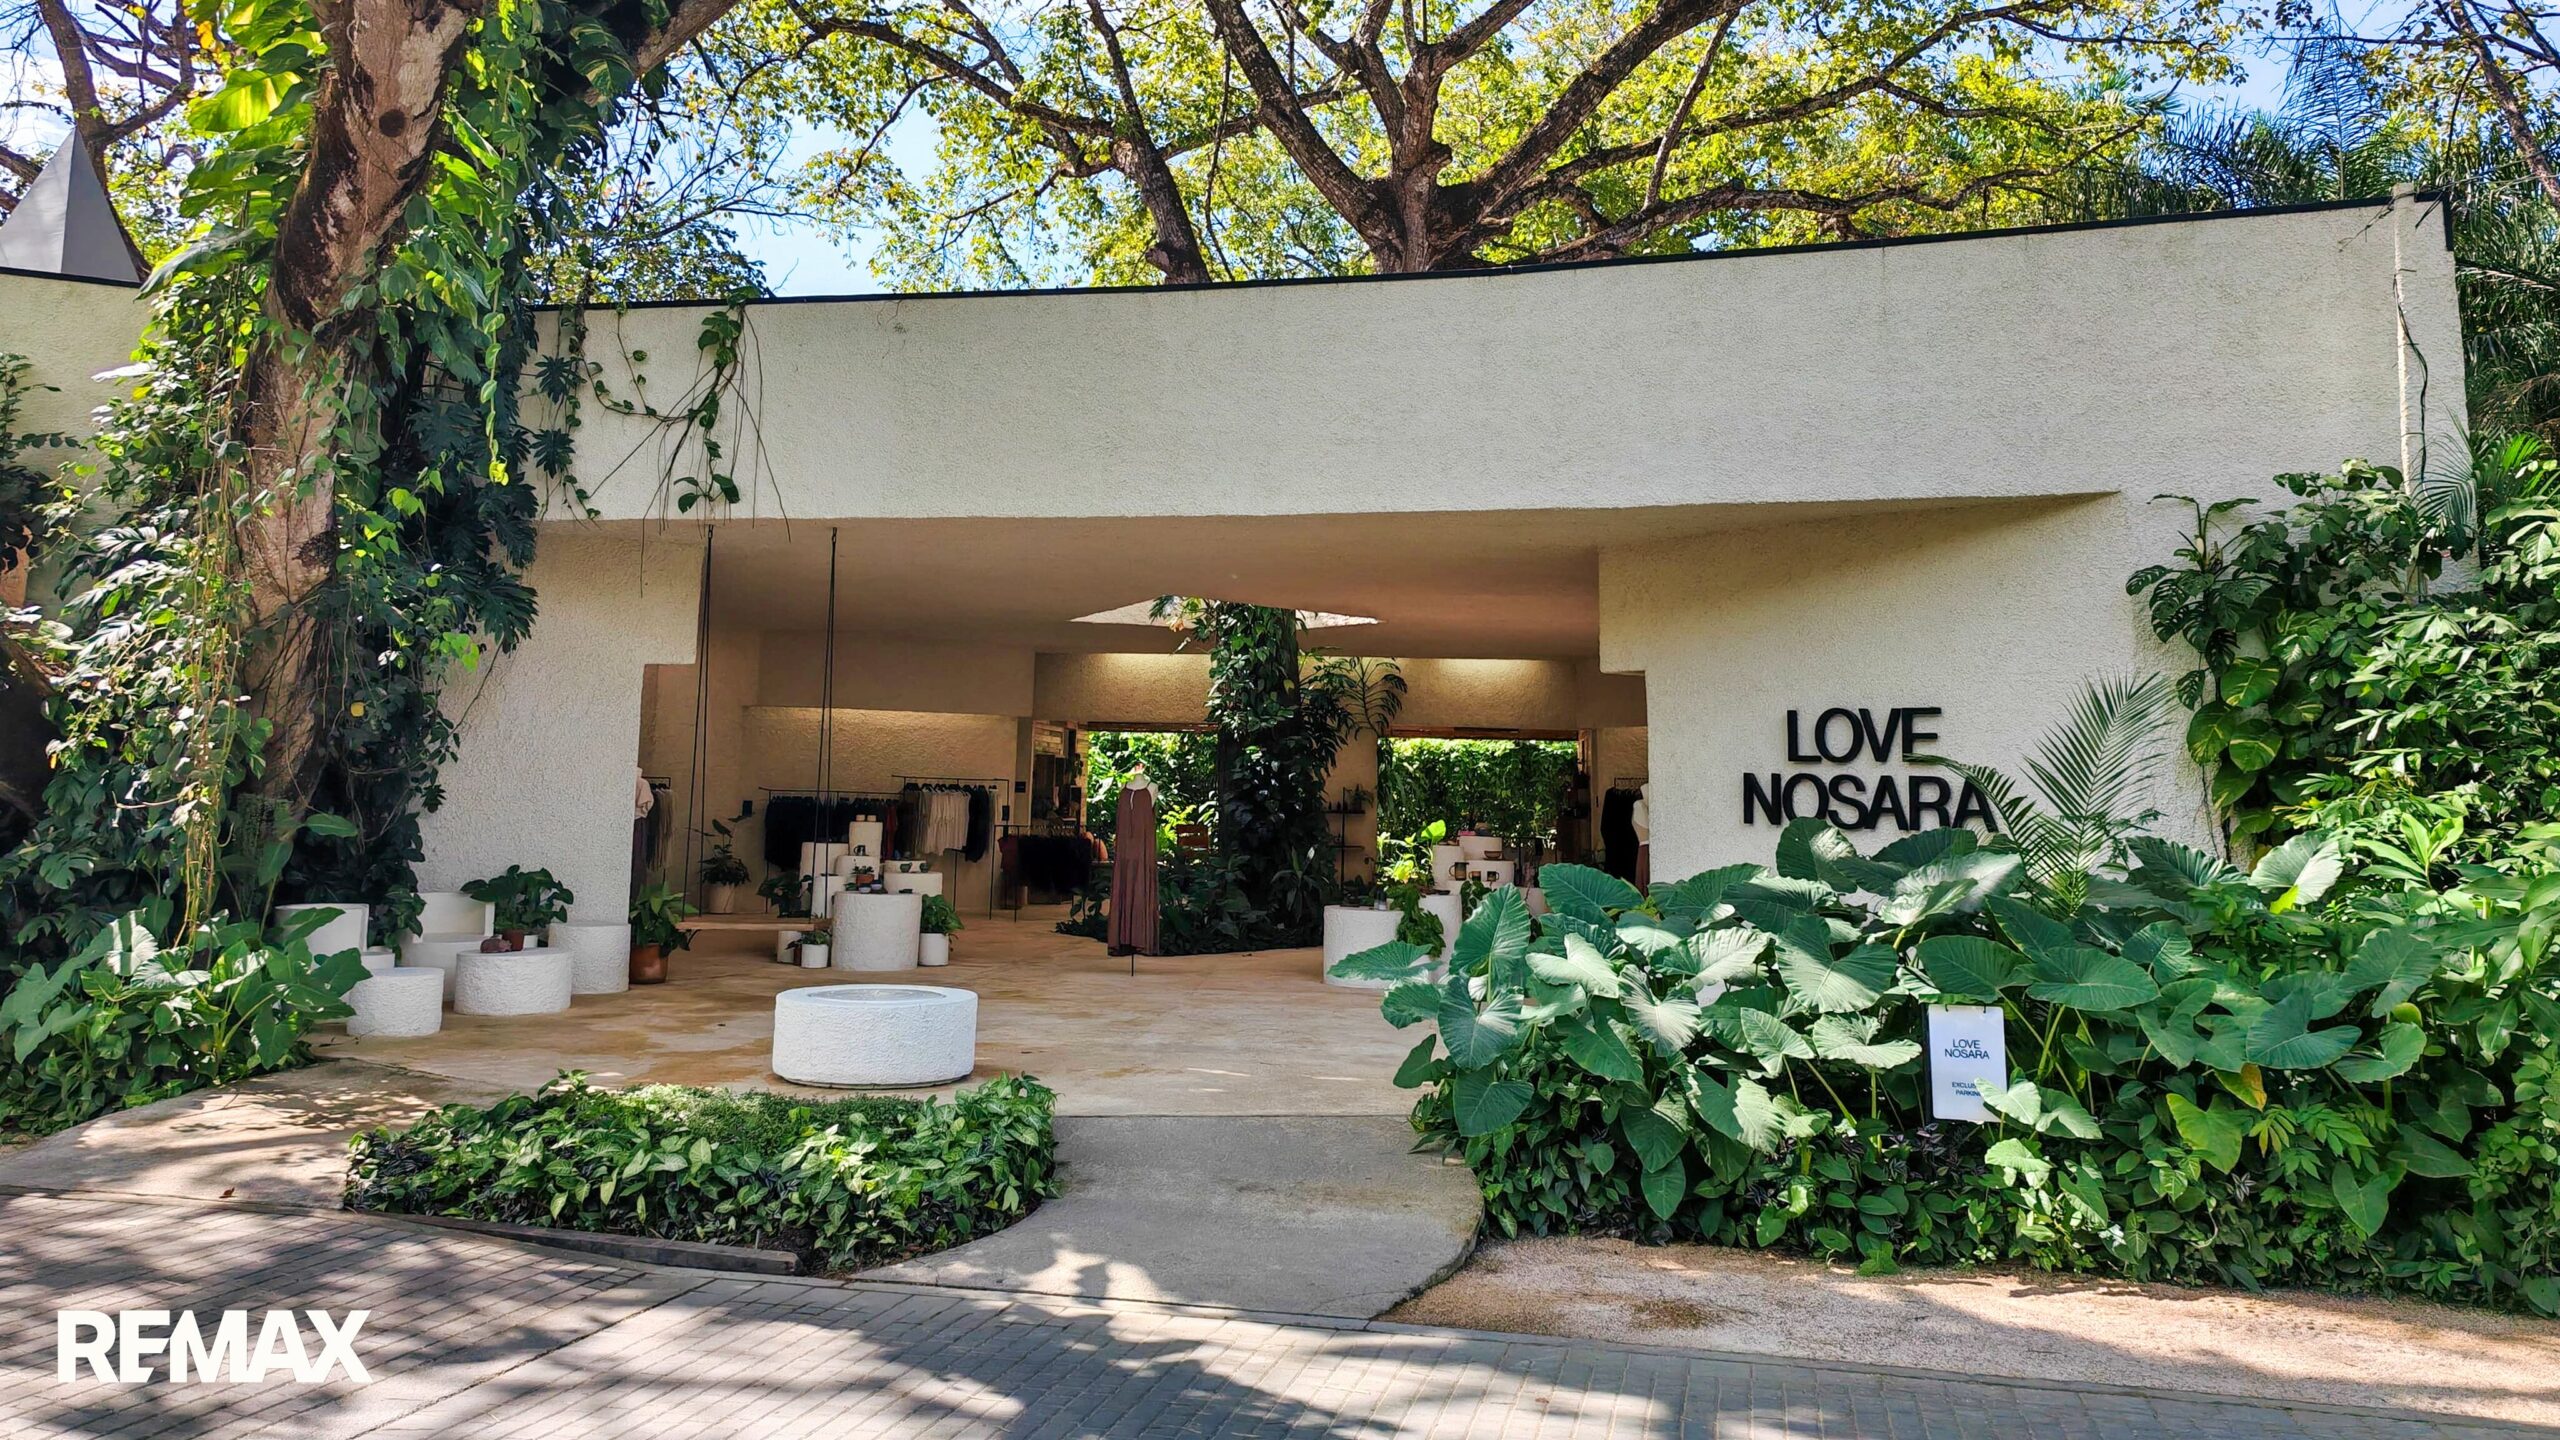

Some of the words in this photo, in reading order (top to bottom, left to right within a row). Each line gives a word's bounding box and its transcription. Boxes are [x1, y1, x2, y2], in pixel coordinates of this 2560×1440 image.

[1786, 707, 1941, 763] LOVE
[1743, 772, 1998, 832] NOSARA
[1952, 1038, 1981, 1049] LOVE
[1944, 1048, 1990, 1060] NOSARA
[1951, 1081, 1977, 1089] EXCLUS
